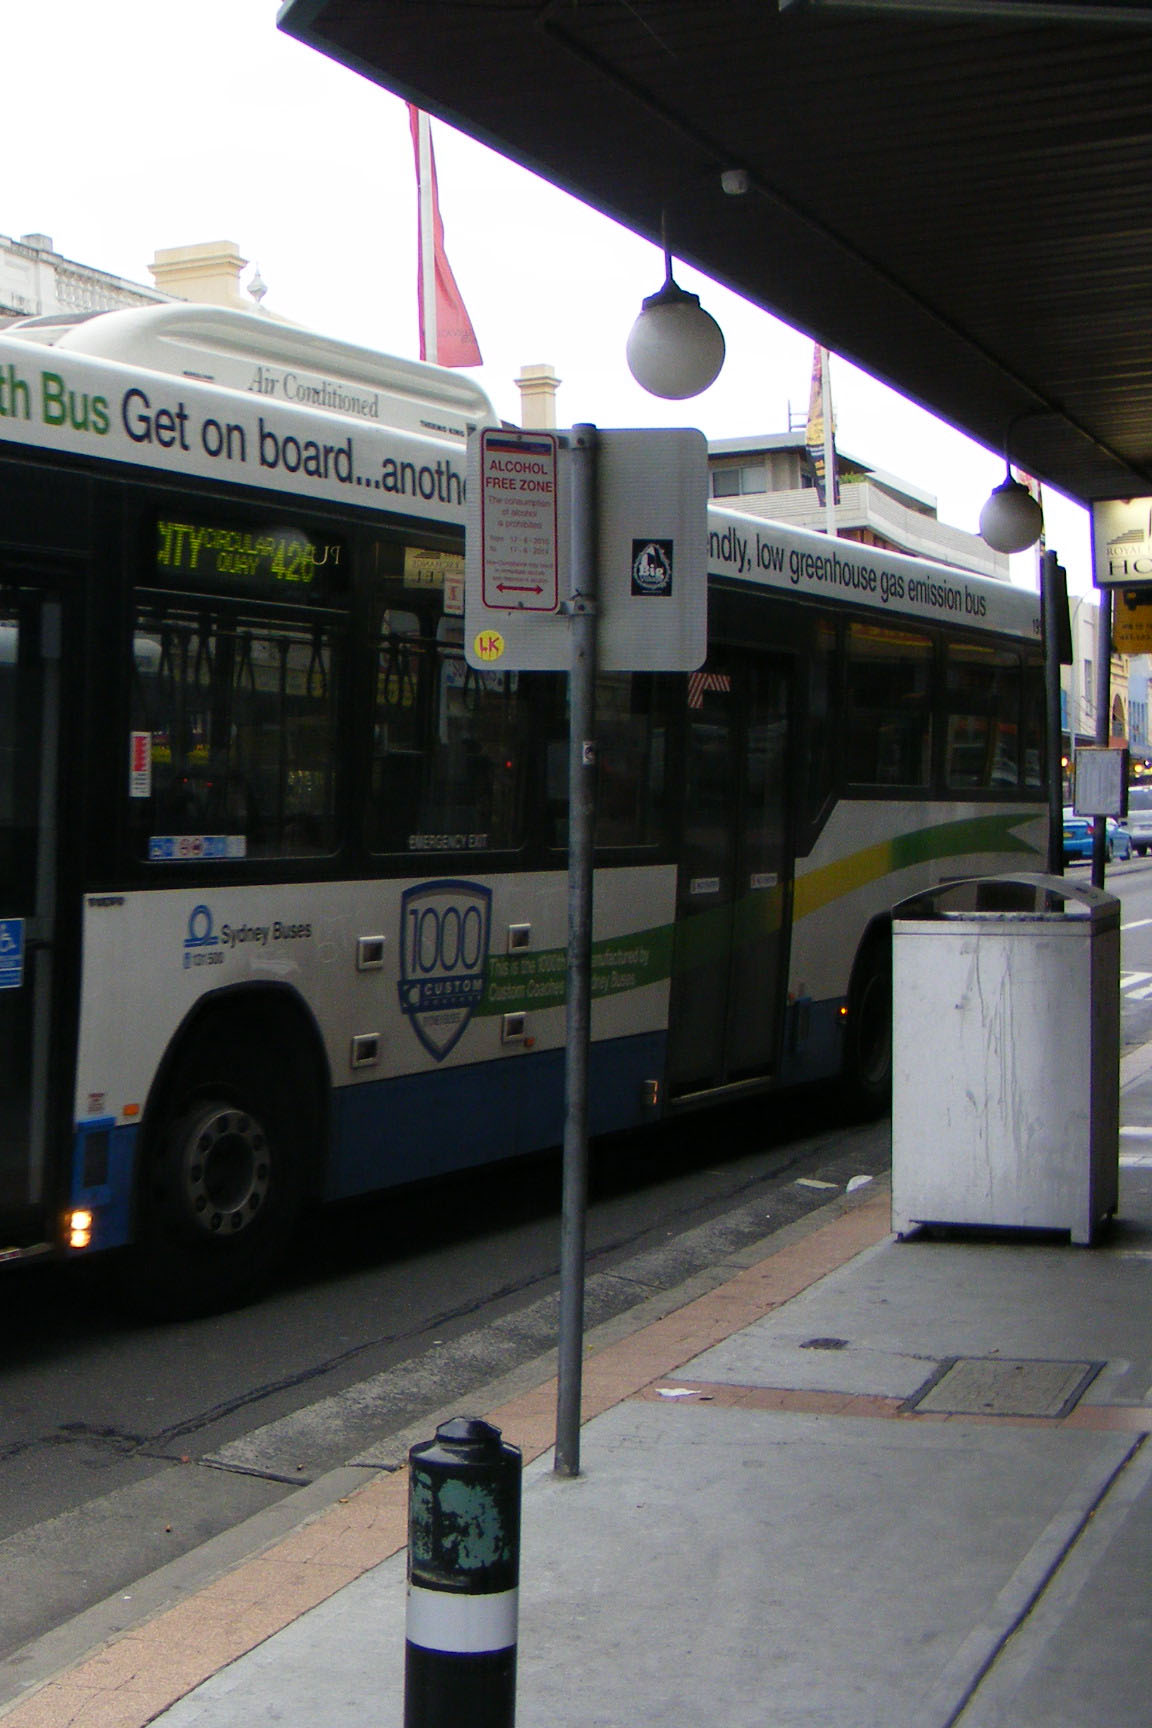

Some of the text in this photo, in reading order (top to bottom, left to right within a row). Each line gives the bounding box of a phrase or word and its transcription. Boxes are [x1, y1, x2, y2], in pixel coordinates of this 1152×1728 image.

[248, 366, 380, 419] Air Conditioned
[40, 370, 111, 436] Bus
[121, 387, 190, 452] Get
[202, 418, 247, 463] on
[489, 459, 548, 476] ALCOHOL
[485, 476, 554, 494] FREE ZONE
[1106, 545, 1142, 556] ROYAL
[707, 527, 987, 617] ndly, low greenhouse gas emission bus
[220, 921, 313, 949] Sydney Buses
[409, 904, 483, 974] 1000
[423, 978, 483, 997] CUSTOM
